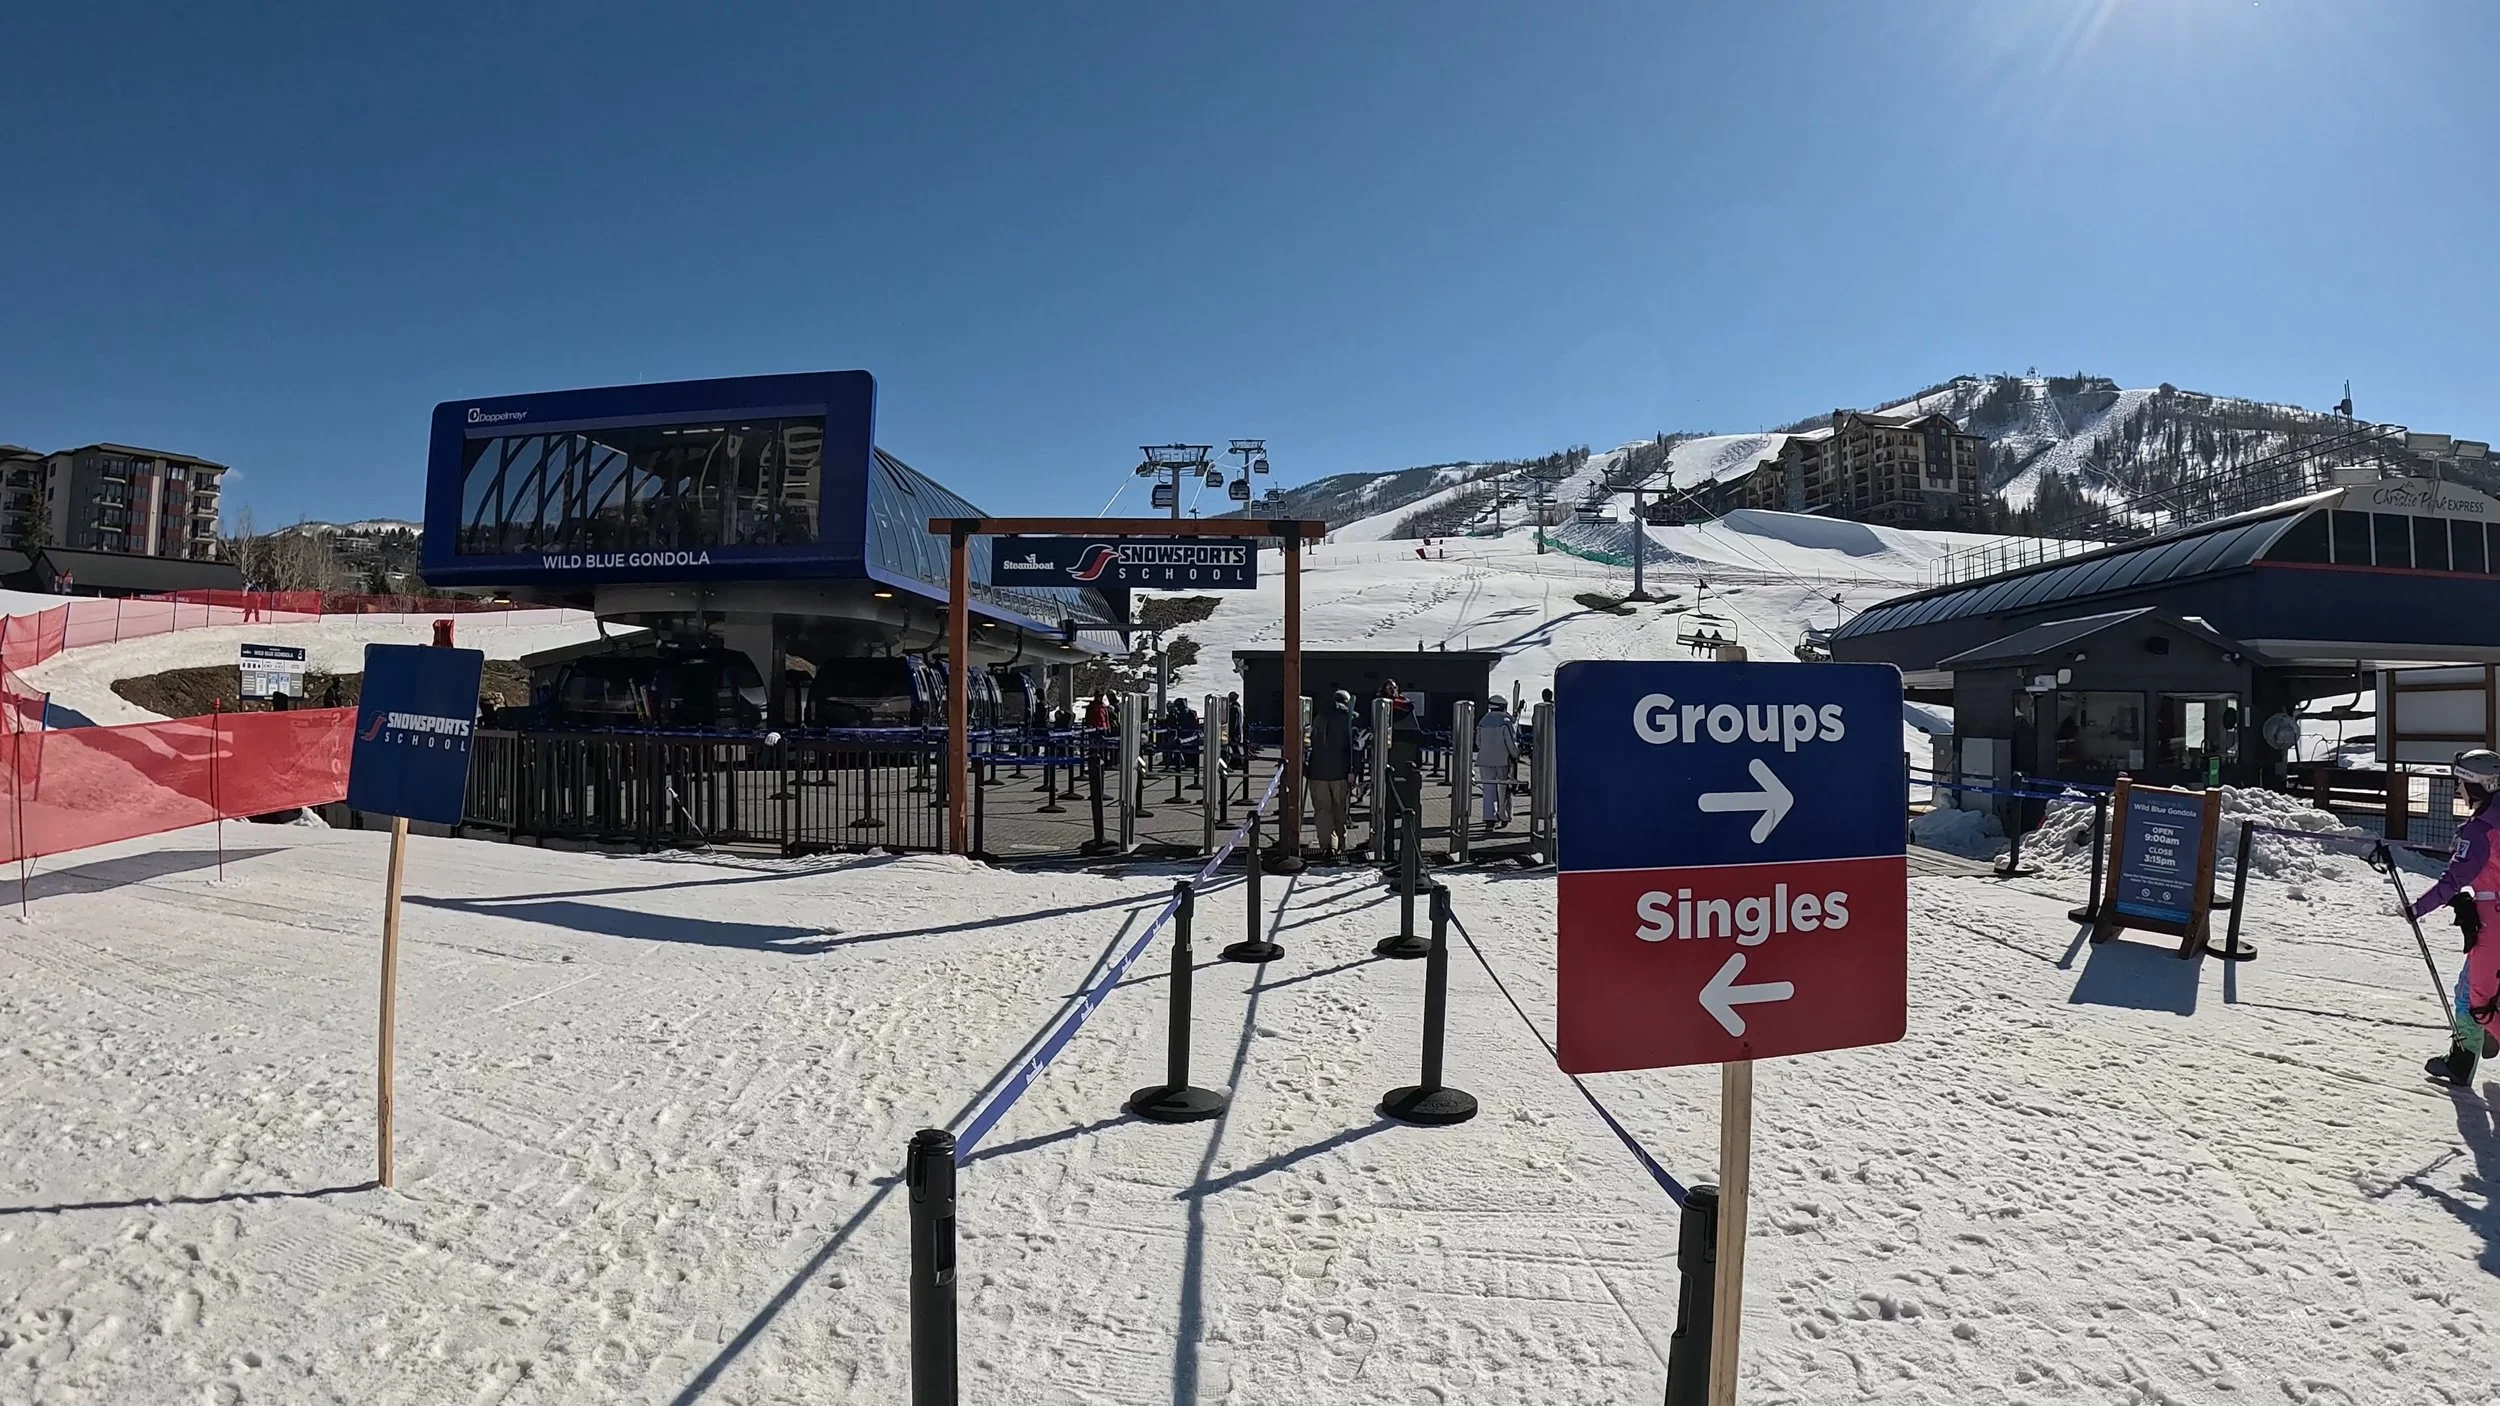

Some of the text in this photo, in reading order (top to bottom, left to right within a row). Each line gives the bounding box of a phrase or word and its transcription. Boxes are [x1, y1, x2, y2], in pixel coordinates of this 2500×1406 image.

[480, 411, 527, 423] Doppelmayr
[2448, 500, 2485, 513] EXPRESS
[543, 551, 711, 569] WILD BLUE GONDOLA
[1003, 555, 1055, 570] Steamboat
[1118, 545, 1246, 565] SNOWSPORTS
[1118, 568, 1243, 581] SCHOOL
[387, 712, 470, 737] SNOWSPORTS
[1633, 693, 1845, 752] Groups
[384, 732, 466, 752] SCHOOL
[2134, 803, 2150, 812] Wild
[2151, 805, 2167, 814] Blue
[2168, 807, 2197, 818] Gondola
[2144, 833, 2180, 845] 9:00am
[2152, 827, 2174, 836] OPEN
[2148, 846, 2174, 857] CLOSE
[2143, 854, 2176, 866] 3:15pm
[1634, 883, 1849, 946] Singles
